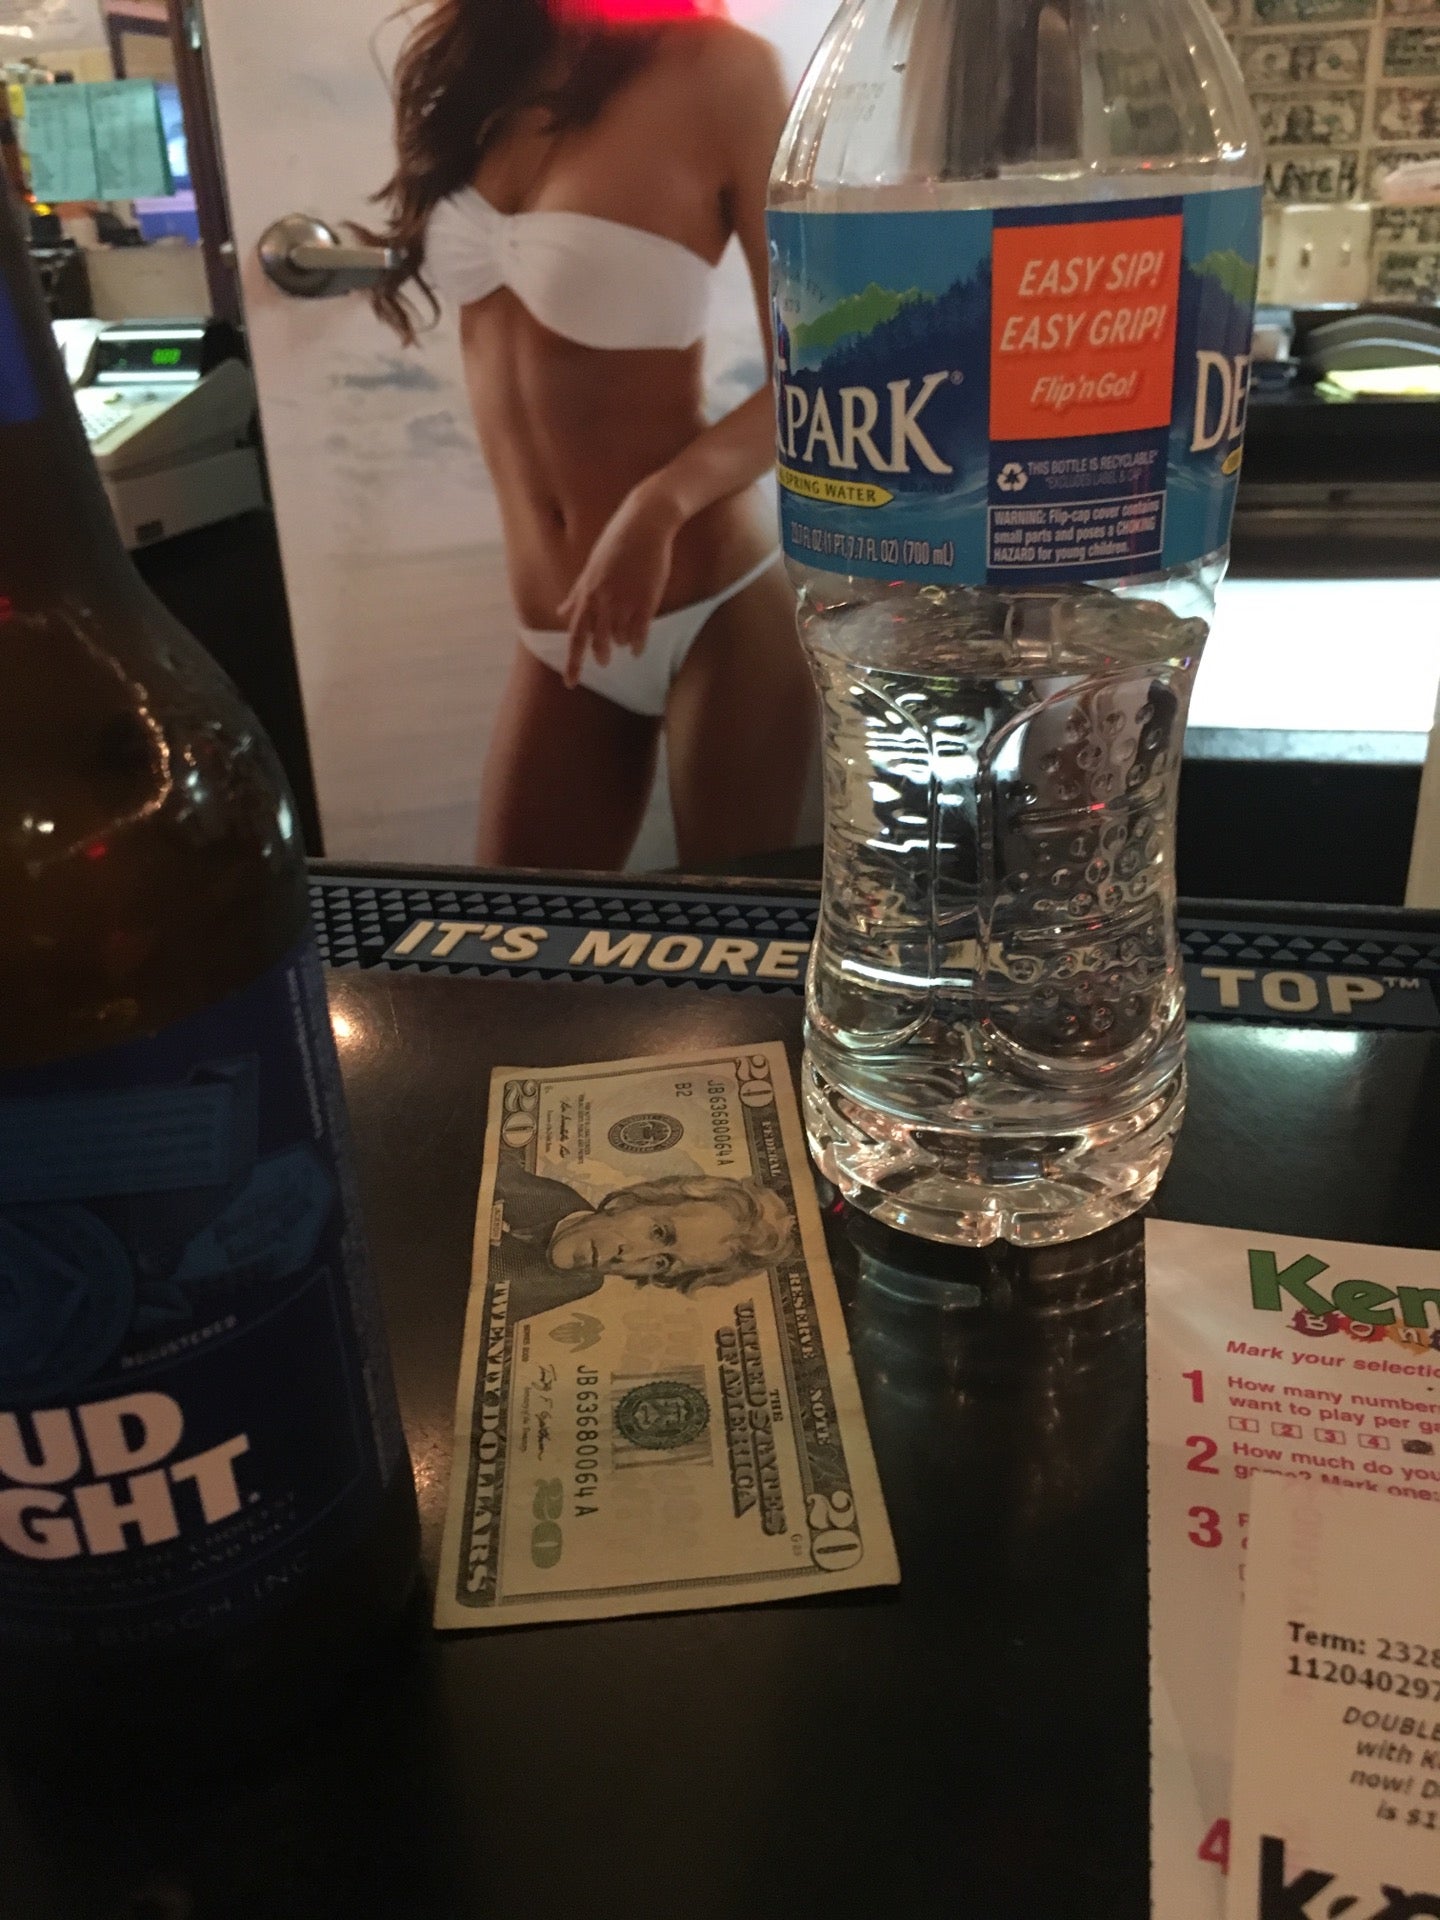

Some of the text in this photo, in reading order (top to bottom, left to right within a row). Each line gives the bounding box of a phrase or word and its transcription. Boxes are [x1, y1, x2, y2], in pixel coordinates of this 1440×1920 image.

[1018, 251, 1164, 297] EASY SIP!
[999, 305, 1167, 352] EASY GRIP!
[784, 370, 953, 474] PARK
[1027, 461, 1050, 476] THIS
[1051, 457, 1087, 474] BOTTLE
[1090, 457, 1099, 471] IS
[824, 483, 876, 503] WATER
[993, 509, 1046, 526] WARNING:
[1049, 507, 1090, 526] Flip-cap
[1092, 505, 1120, 521] cover
[993, 530, 1023, 545] small
[1025, 530, 1051, 546] parts
[1055, 526, 1074, 542] and
[1076, 526, 1106, 543] poses
[993, 547, 1036, 562] HAZARD
[1037, 546, 1053, 561] for
[1055, 545, 1086, 563] young
[394, 920, 549, 962] IT'S
[568, 930, 811, 980] MORE
[736, 1055, 775, 1108] 20
[502, 1080, 538, 1149] 20
[761, 1120, 832, 1446] FEDERAL RESERVE NOTE
[1247, 1248, 1440, 1329] Ken
[1226, 1340, 1283, 1360] Mark
[1291, 1350, 1346, 1366] your
[769, 1388, 784, 1422] THE
[1182, 1369, 1205, 1404] 1
[1228, 1375, 1440, 1415] How many number
[734, 1299, 788, 1537] UNITED STATES
[1229, 1395, 1283, 1413] want
[1289, 1402, 1312, 1417] to
[1319, 1407, 1365, 1427] play
[1374, 1414, 1411, 1429] per
[0, 1391, 185, 1485] UD
[466, 1281, 511, 1594] TWENTY DOLLARS
[720, 1364, 757, 1519] AMERICA
[1185, 1435, 1220, 1476] 2
[1281, 1424, 1293, 1438] 2
[1324, 1429, 1337, 1443] 3
[1367, 1435, 1380, 1448] 4
[1233, 1441, 1283, 1461] How
[1291, 1451, 1356, 1471] much
[1363, 1459, 1394, 1476] do
[530, 1477, 564, 1570] 20
[805, 1491, 864, 1572] 20
[1187, 1505, 1223, 1549] 3
[1287, 1620, 1366, 1655] Term:
[1356, 1739, 1414, 1765] with
[1377, 1799, 1398, 1821] is
[1197, 1816, 1231, 1876] 4
